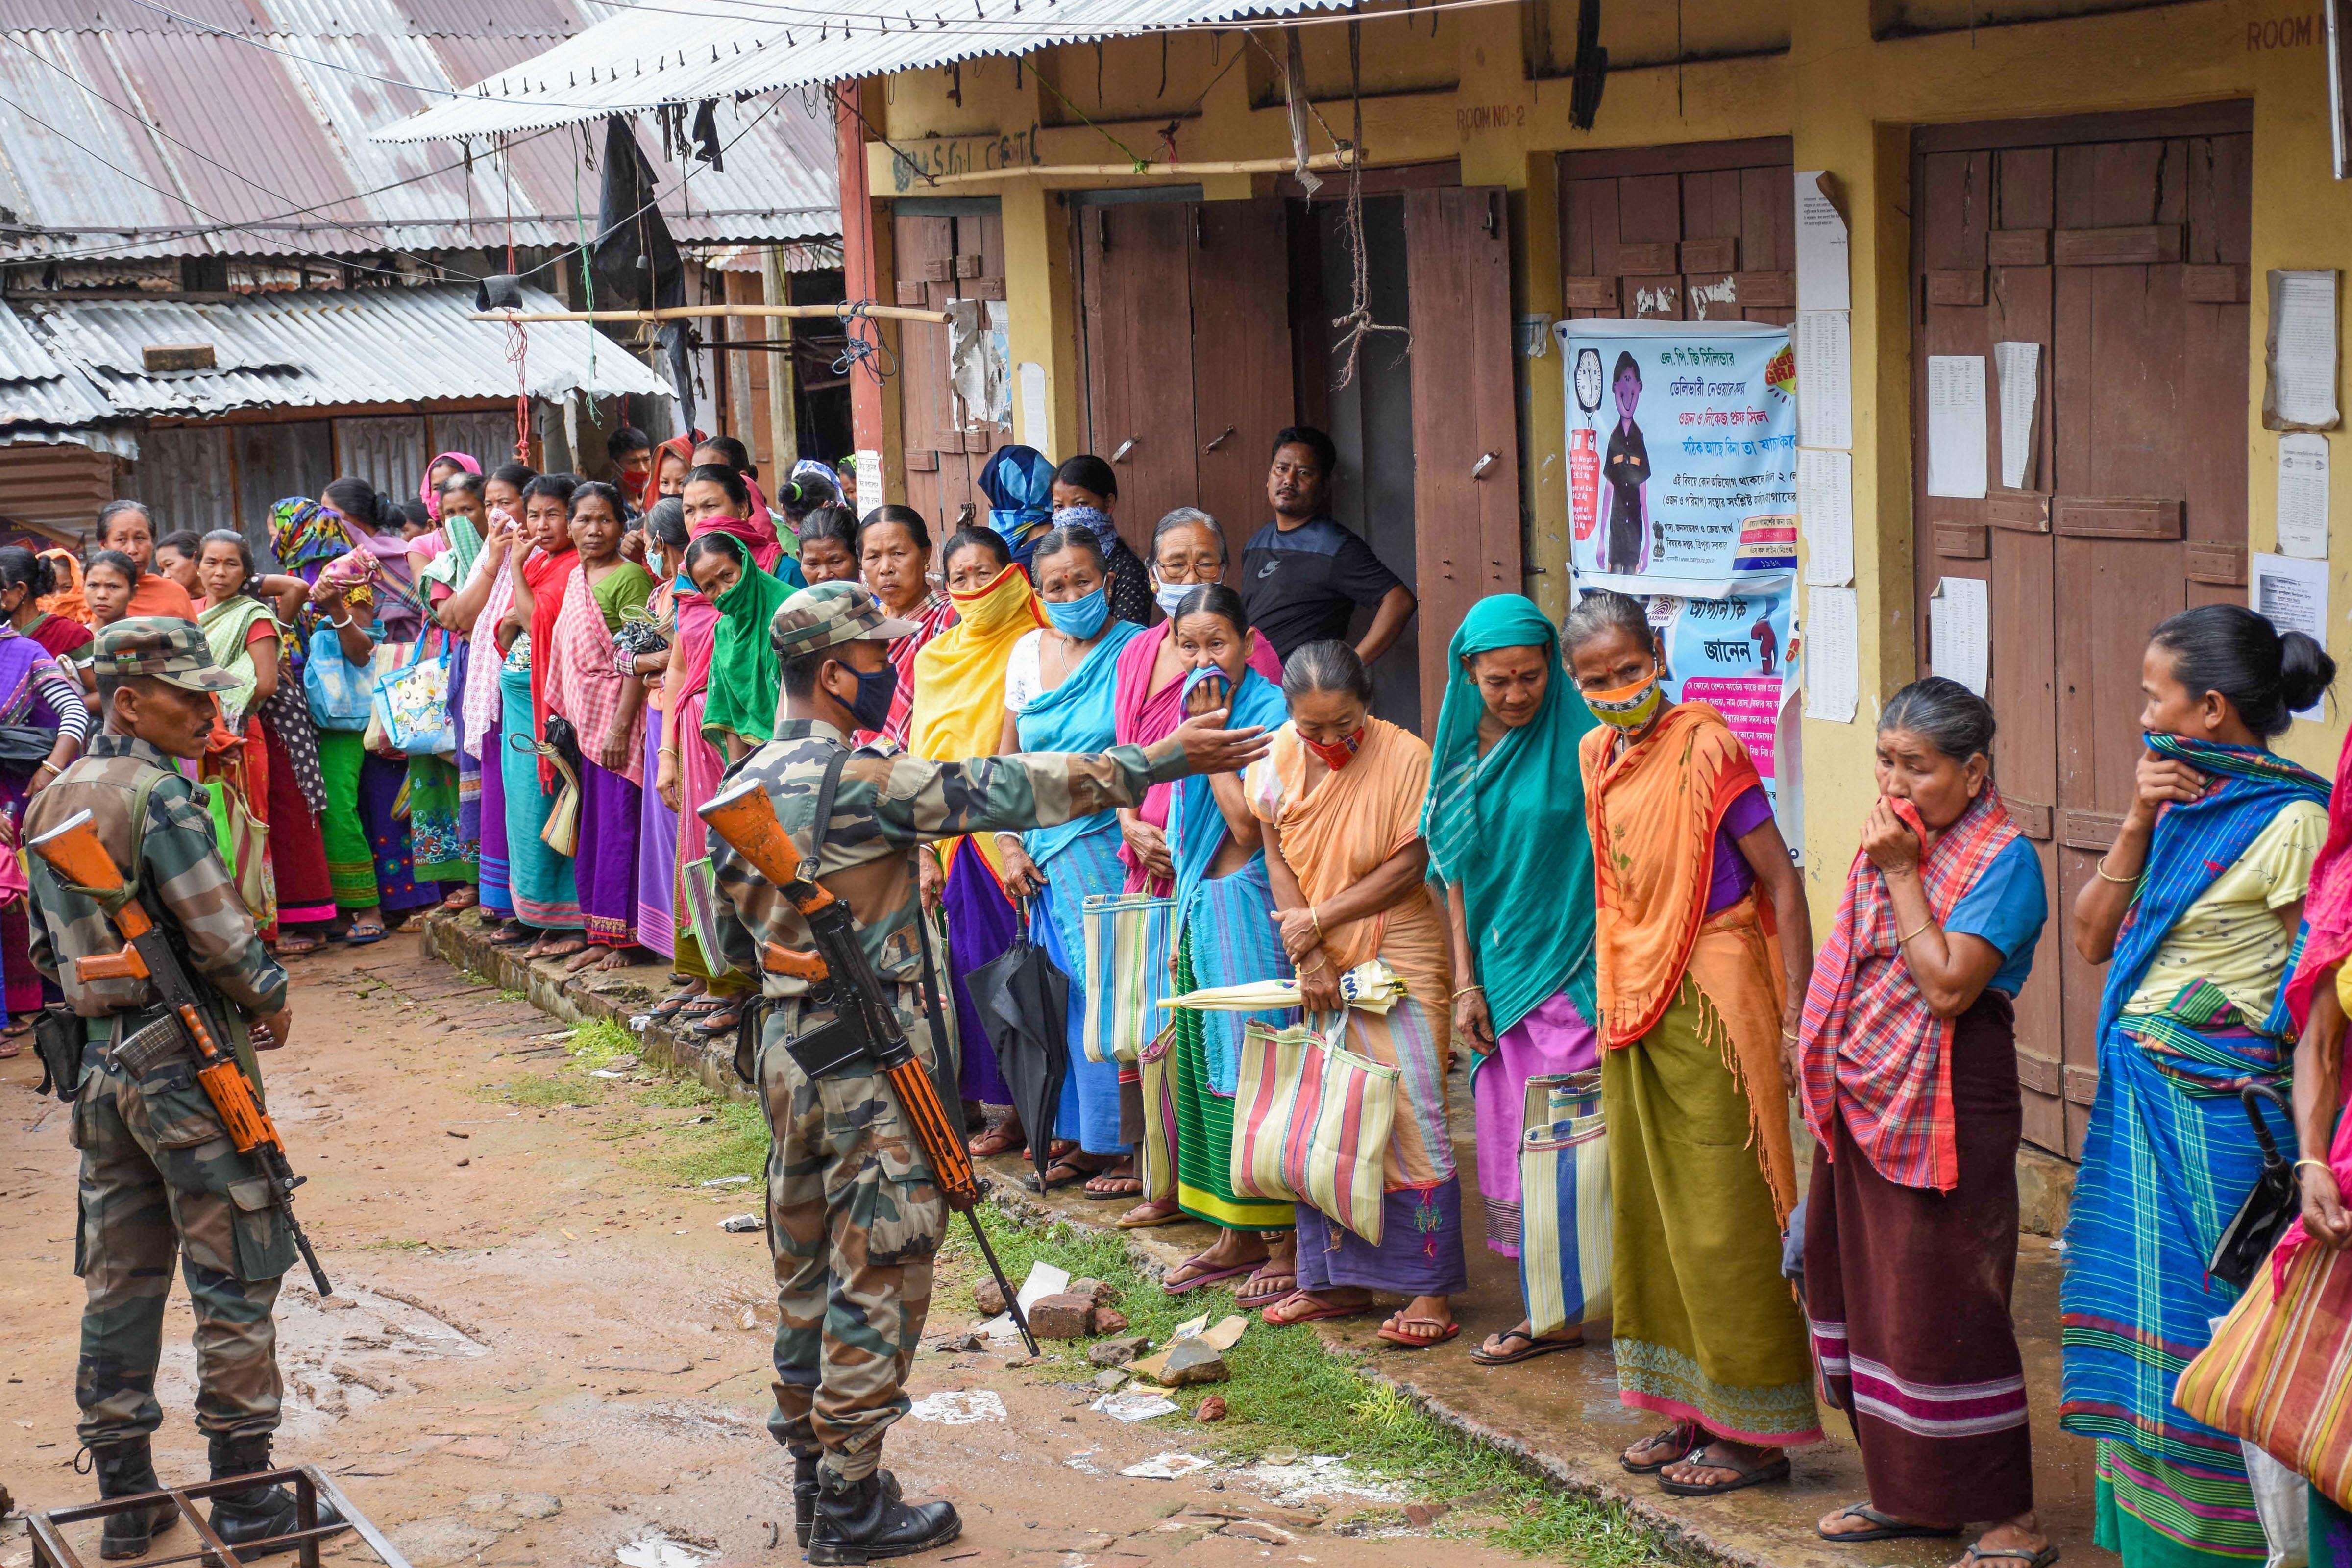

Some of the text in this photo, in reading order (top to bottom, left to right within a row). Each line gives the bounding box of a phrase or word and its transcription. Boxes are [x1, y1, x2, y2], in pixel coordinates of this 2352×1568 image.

[2247, 14, 2311, 51] ROOM
[1457, 106, 1490, 130] ROOM
[1688, 347, 1700, 366] জি
[1699, 347, 1735, 367] সিলিন্ডার
[1670, 376, 1704, 397] ডেলিভারী
[1679, 412, 1695, 426] ওজন
[1697, 413, 1703, 425] ও
[1703, 407, 1729, 427] লিকেজ
[1746, 406, 1769, 426] সিল
[1682, 436, 1703, 456] সঠিক
[1703, 441, 1724, 457] আছে
[1740, 440, 1758, 455] তা
[1673, 474, 1681, 487] এই
[1699, 476, 1710, 488] কোন
[1711, 474, 1737, 488] অভিযোগ
[1711, 541, 1728, 550] সরকার
[1729, 596, 1747, 620] কি
[1704, 638, 1752, 662] জানেন
[1693, 682, 1709, 690] কোনো
[1725, 680, 1743, 692] কার্ডের
[1743, 683, 1757, 692] কাজে
[1726, 698, 1735, 707] নাম
[1738, 731, 1755, 740] কোনো
